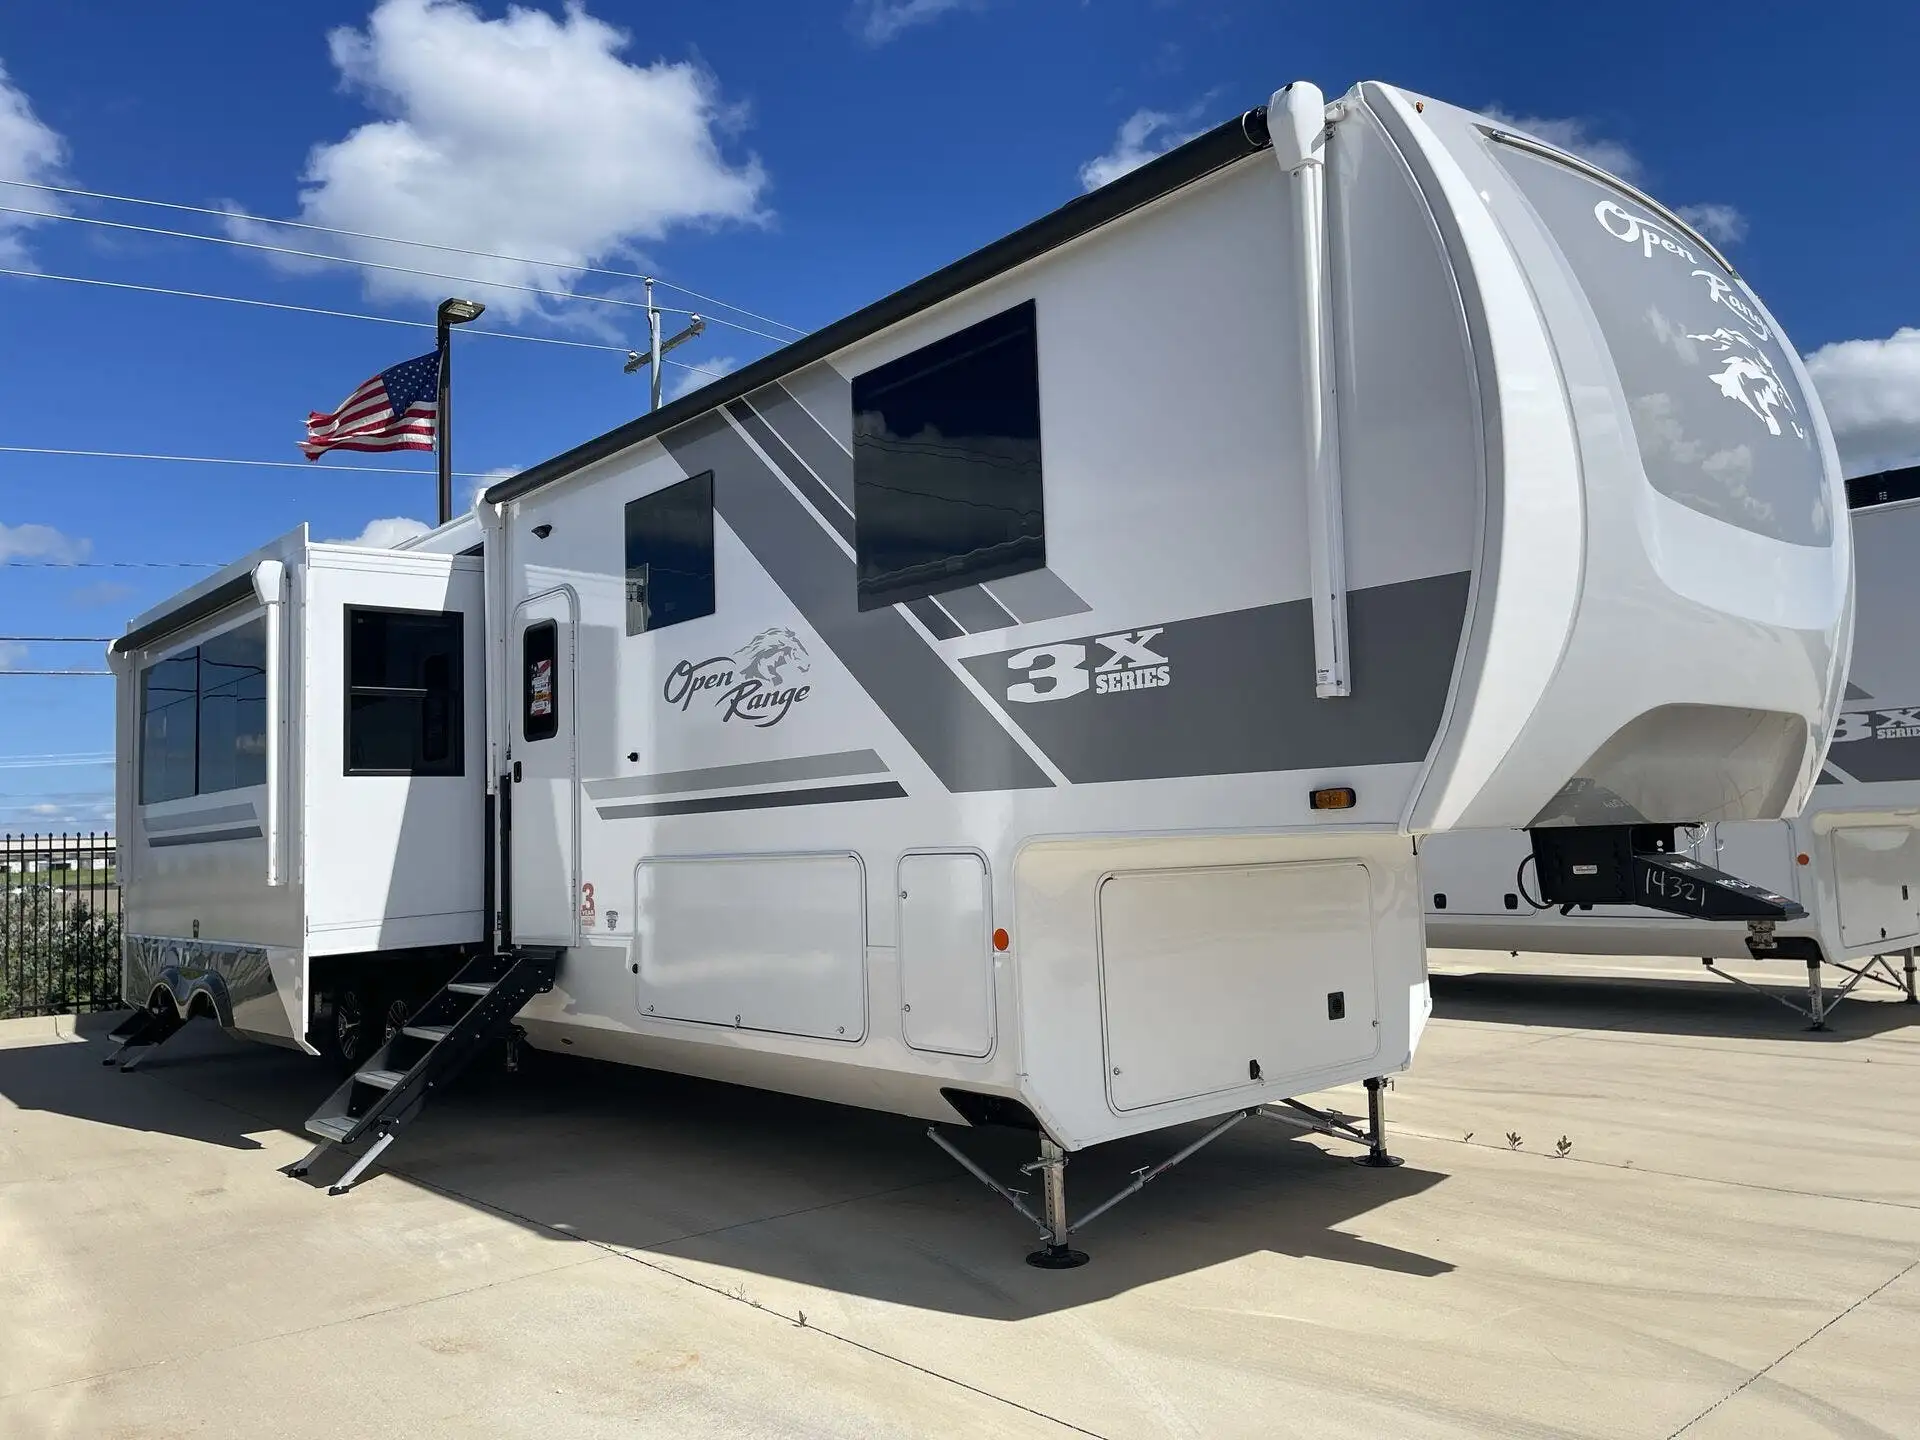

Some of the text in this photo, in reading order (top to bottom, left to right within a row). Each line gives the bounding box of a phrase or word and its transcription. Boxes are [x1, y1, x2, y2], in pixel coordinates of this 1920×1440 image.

[1594, 200, 1698, 264] Open
[663, 656, 737, 712] Open
[1095, 665, 1171, 695] SERIES
[714, 679, 811, 728] Range
[1876, 726, 1920, 740] SERIE
[582, 882, 595, 910] 3
[1645, 867, 1706, 907] 14321
